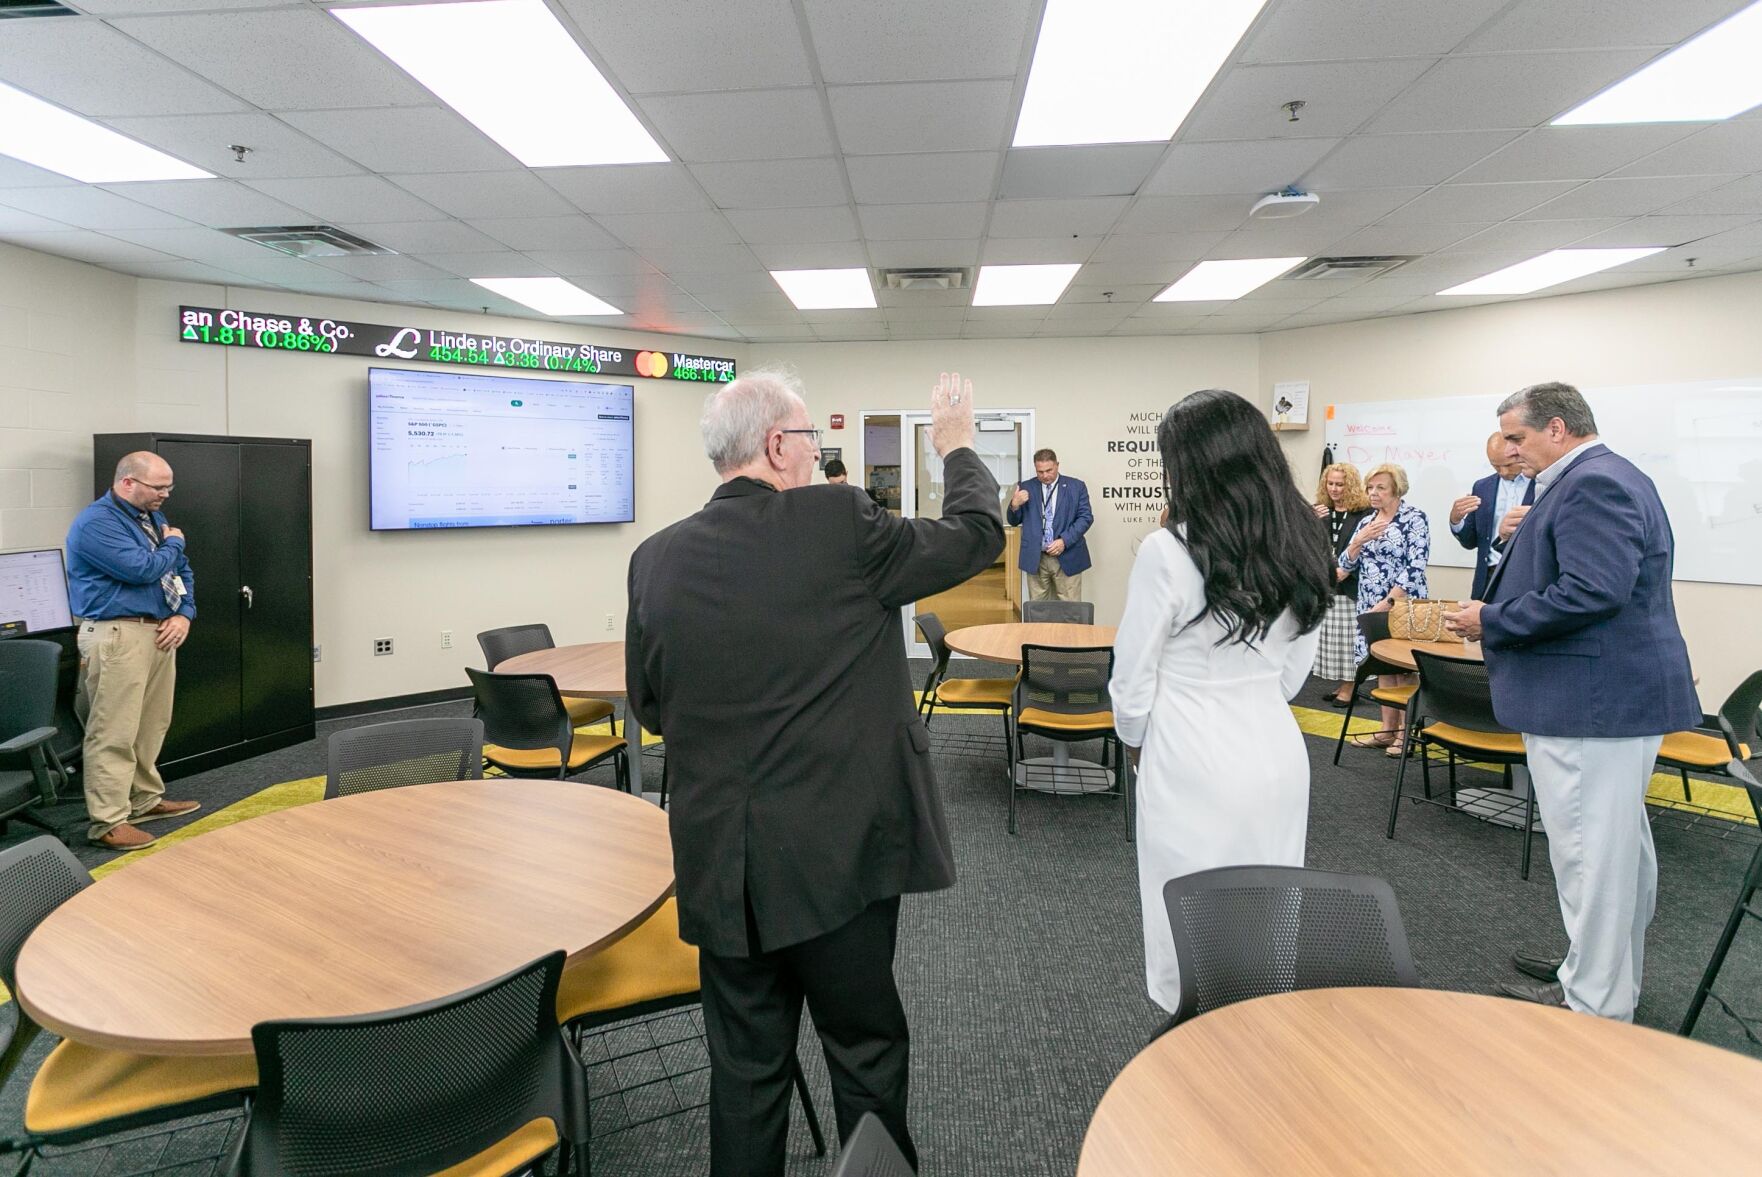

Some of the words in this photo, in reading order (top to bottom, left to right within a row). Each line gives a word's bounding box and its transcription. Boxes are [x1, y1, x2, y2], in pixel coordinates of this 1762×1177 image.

[183, 310, 212, 327] an
[220, 310, 292, 333] Chase
[298, 318, 313, 336] &
[319, 320, 355, 339] Co.
[199, 325, 246, 346] 1.81
[255, 330, 338, 353] (0.86%)
[429, 330, 477, 350] Linde
[482, 337, 507, 353] plc
[510, 339, 576, 359] Ordinary
[579, 345, 622, 363] Share
[429, 346, 489, 365] 454.54
[505, 352, 540, 369] 3.36
[544, 353, 602, 373] (0.74%)
[673, 354, 734, 371] Mastercar
[673, 367, 716, 383] 466.14
[1130, 413, 1163, 421] MUCH
[1127, 426, 1151, 434] WILL
[1107, 441, 1160, 453] REQUI
[1128, 459, 1143, 467] OF
[1103, 487, 1170, 498] ENTRUST
[1115, 503, 1141, 511] WITH
